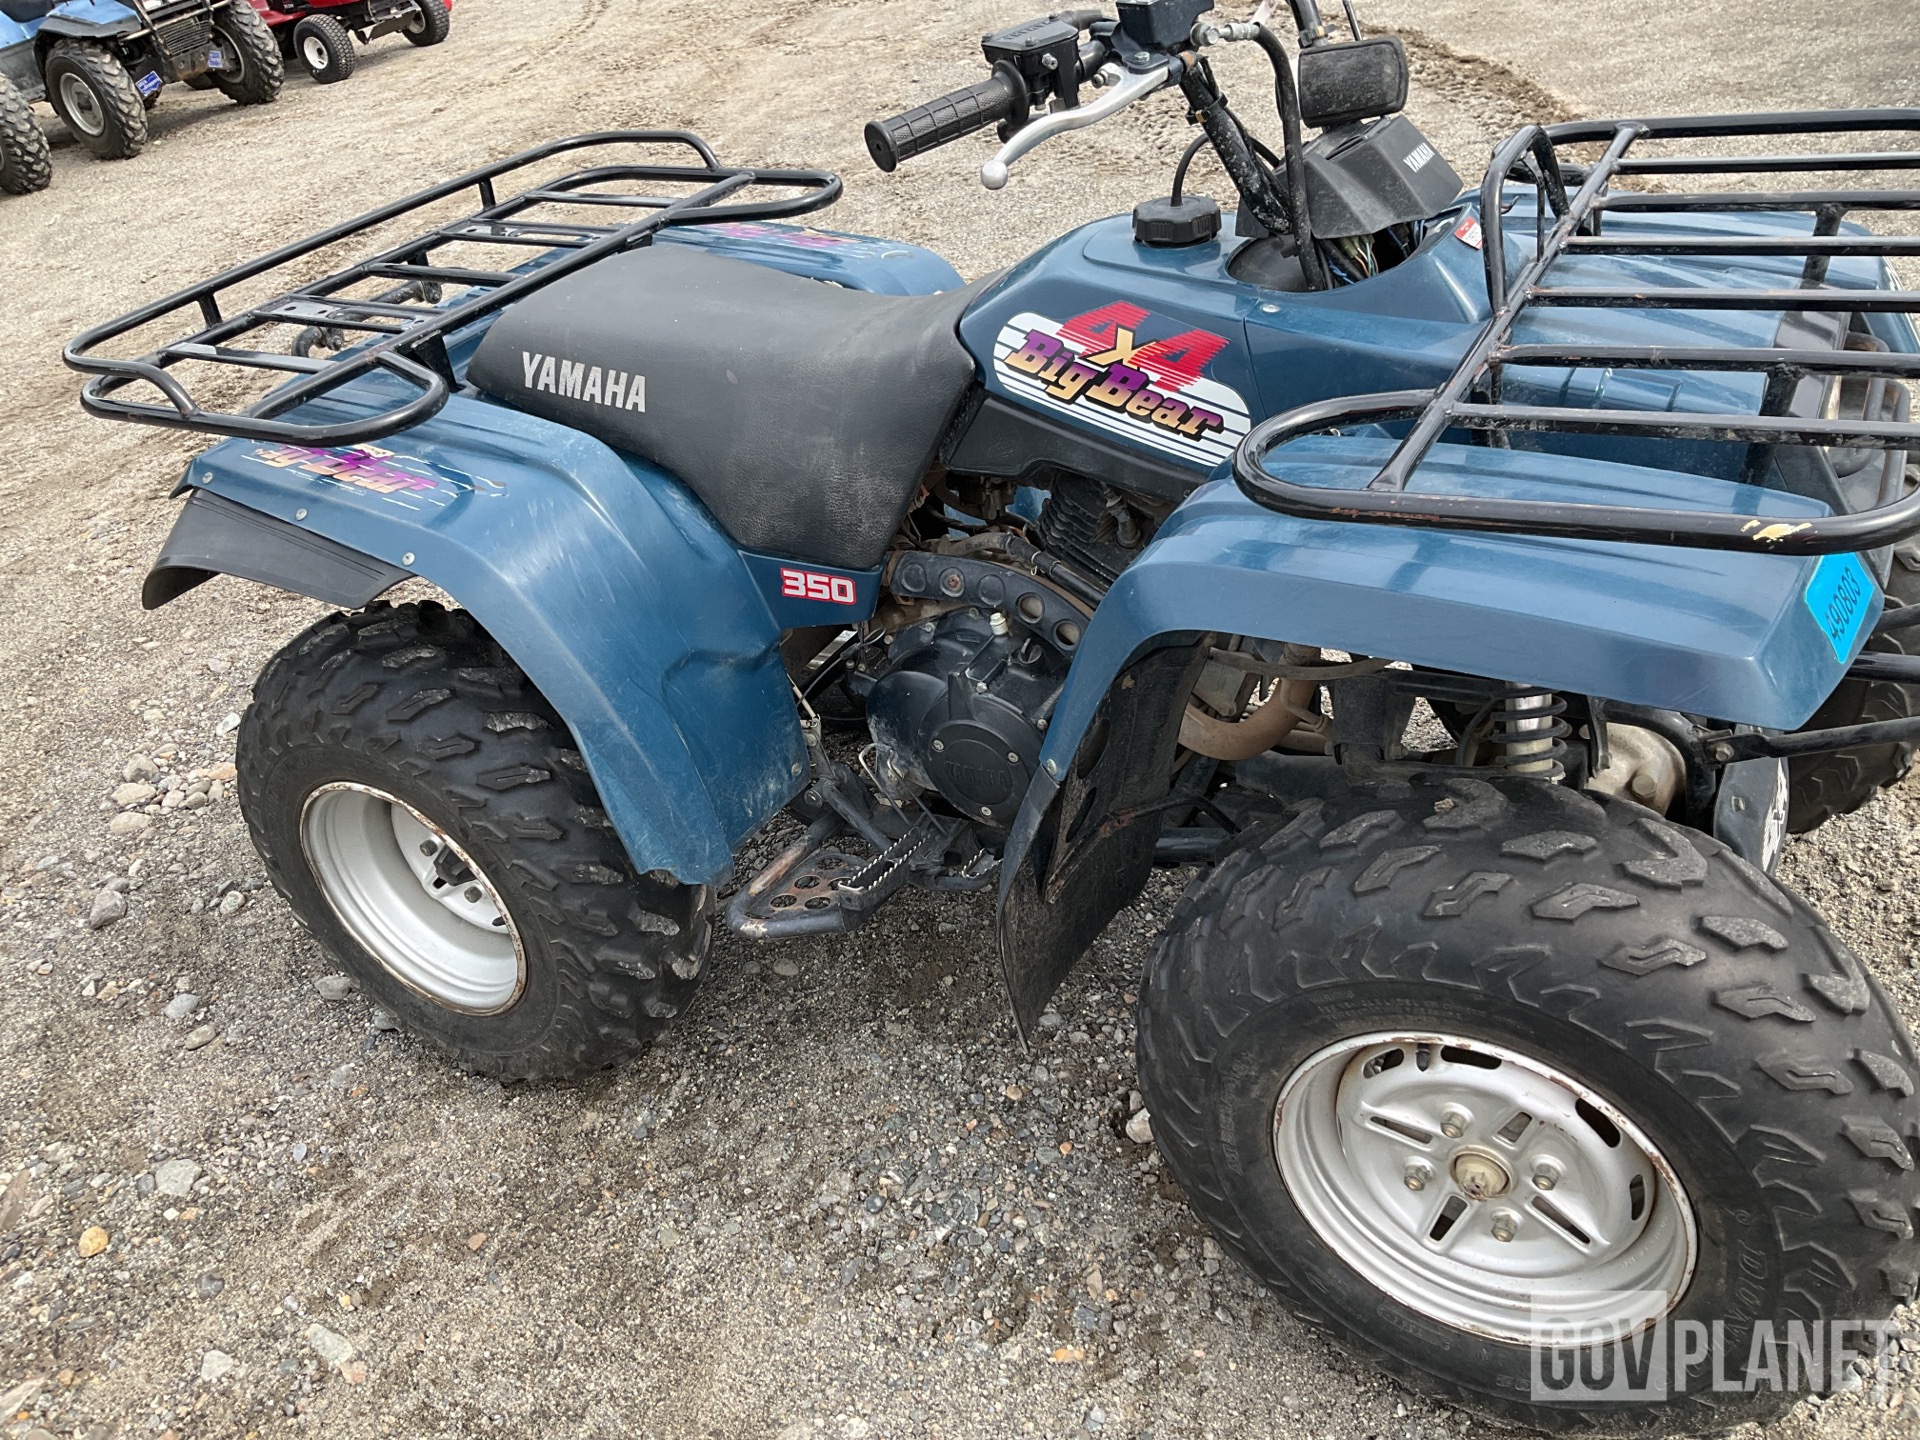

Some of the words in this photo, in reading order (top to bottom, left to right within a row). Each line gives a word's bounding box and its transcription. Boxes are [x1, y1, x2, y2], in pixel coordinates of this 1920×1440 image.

[1402, 142, 1436, 173] YAMAHA
[522, 351, 646, 413] YAMAHA
[1004, 329, 1098, 405] Big
[1084, 361, 1224, 442] Bear
[781, 568, 856, 605] 350
